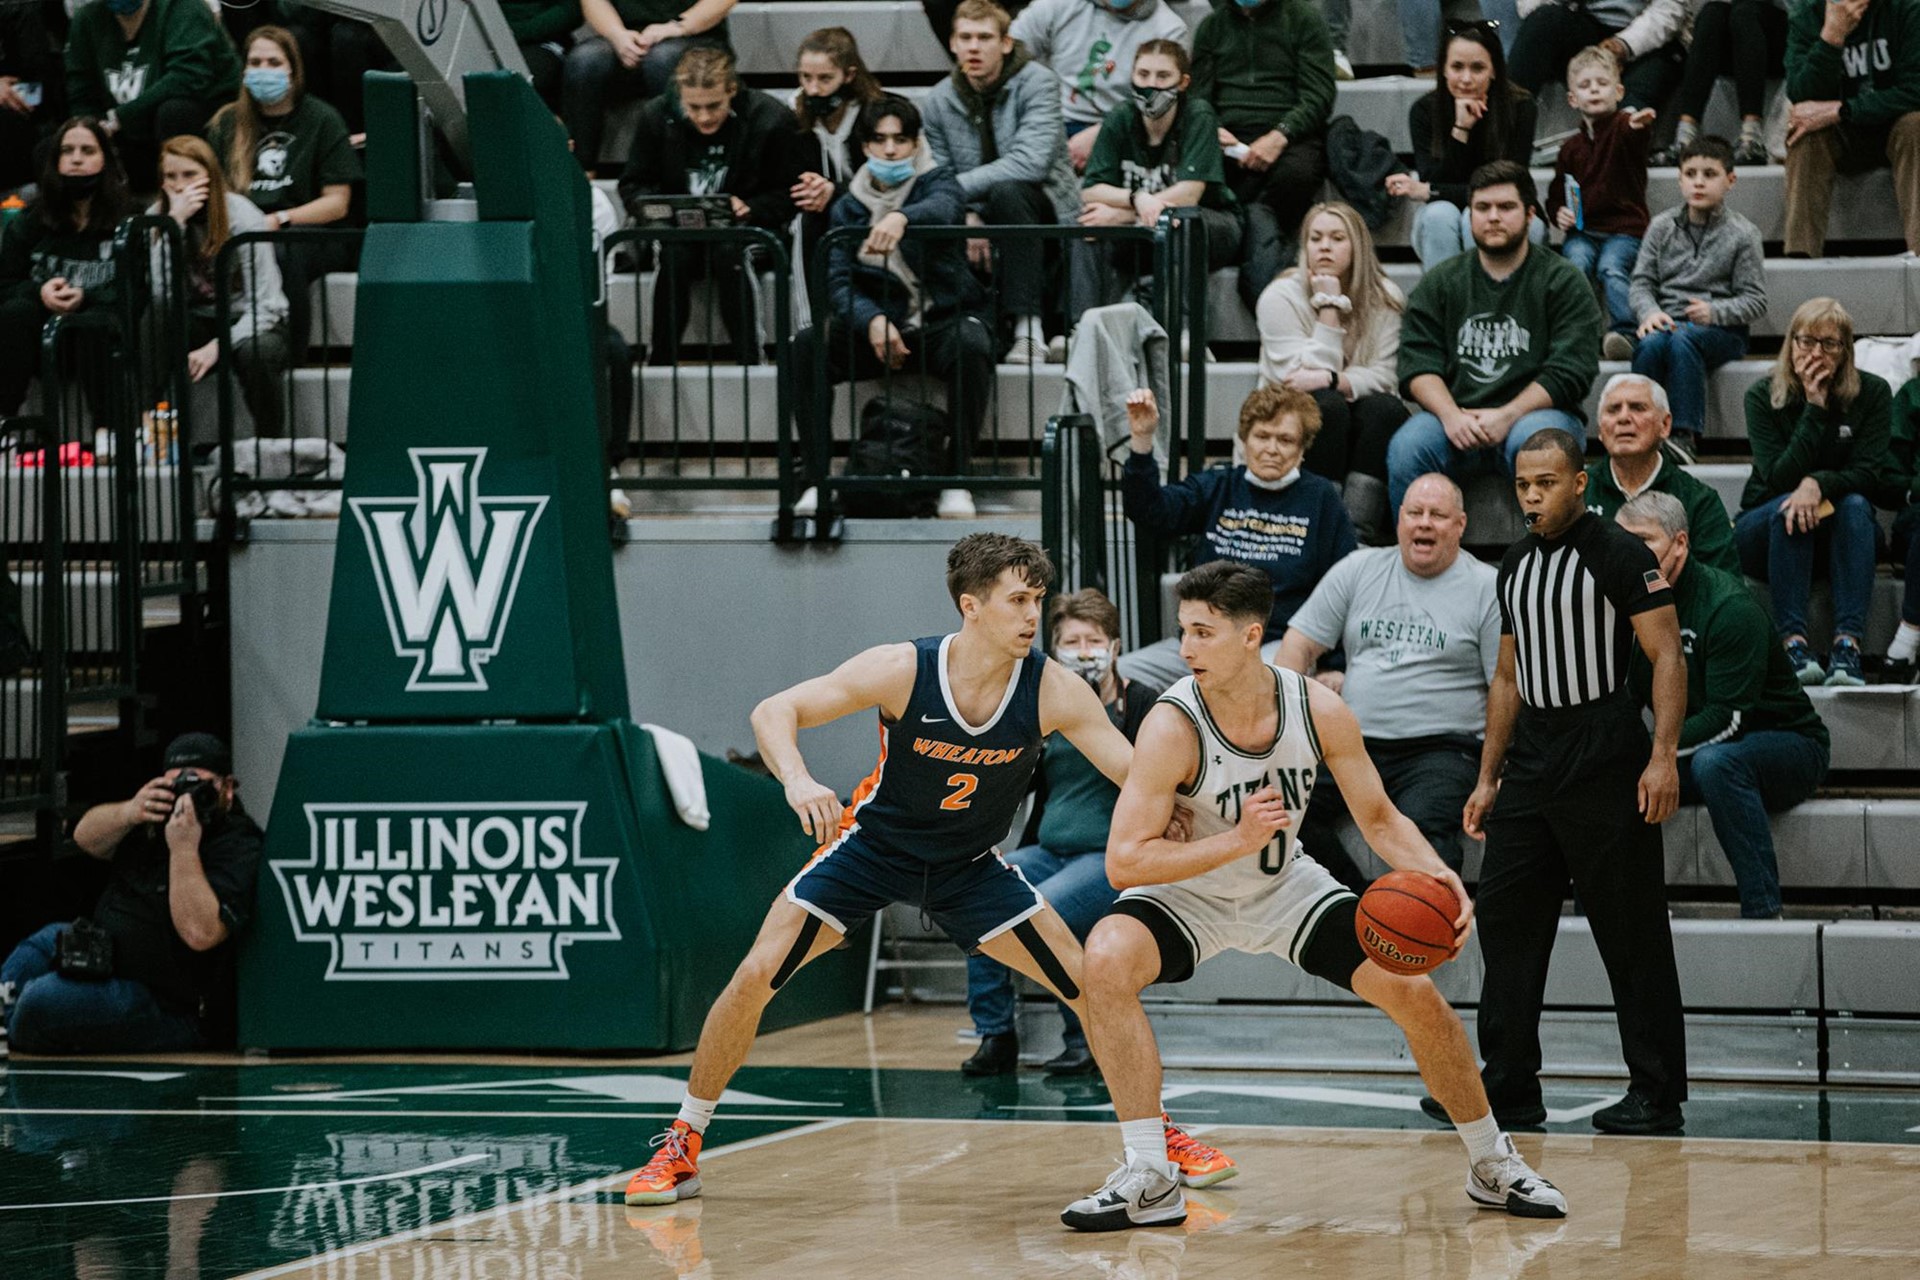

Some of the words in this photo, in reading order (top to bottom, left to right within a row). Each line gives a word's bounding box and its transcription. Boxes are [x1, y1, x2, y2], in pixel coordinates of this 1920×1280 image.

[1360, 618, 1447, 651] WESLEYAN
[912, 736, 1024, 765] WHEATON
[939, 773, 979, 811] 2
[323, 815, 568, 870] ILLINOIS
[1259, 828, 1286, 875] 0
[293, 872, 599, 927] WESLEYAN
[359, 940, 534, 961] TITANS
[1363, 923, 1428, 965] Wilson
